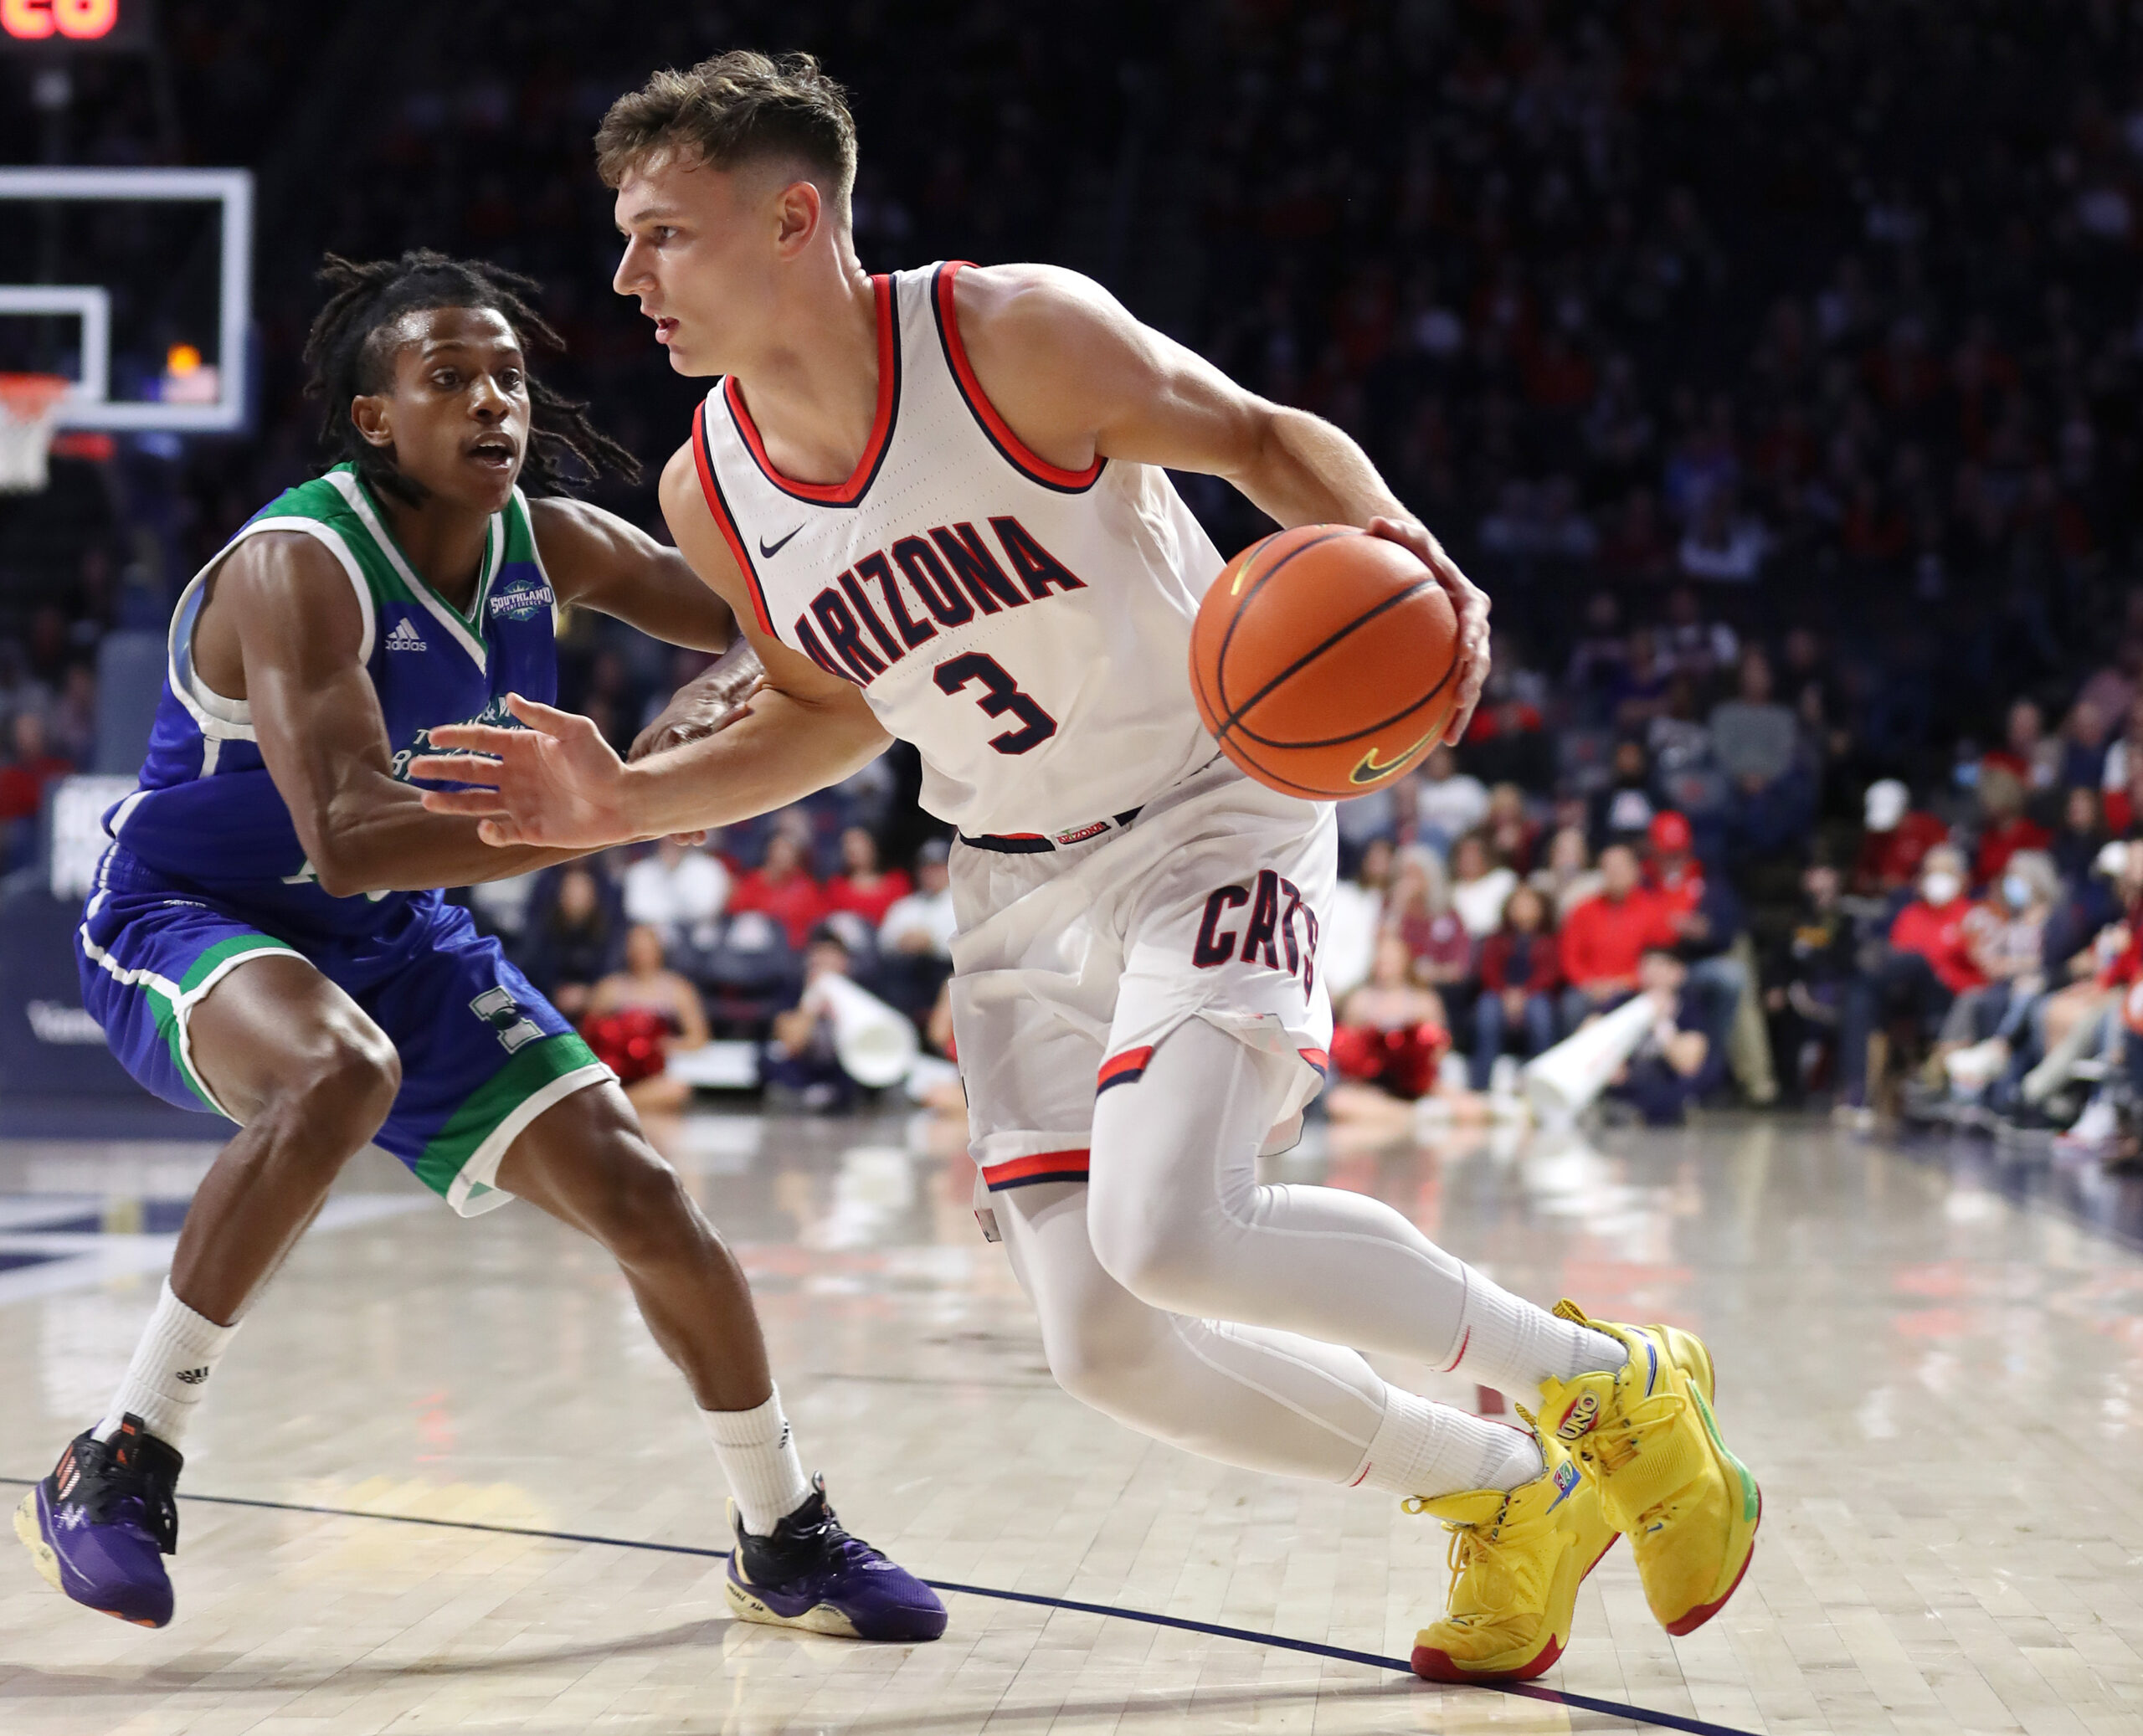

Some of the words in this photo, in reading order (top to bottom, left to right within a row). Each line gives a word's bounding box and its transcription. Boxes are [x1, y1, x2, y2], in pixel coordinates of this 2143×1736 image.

[490, 586, 553, 614] SOUTHLAND
[794, 515, 1089, 689] ARIZONA
[933, 650, 1058, 755] 3
[1556, 1391, 1600, 1441] UNO
